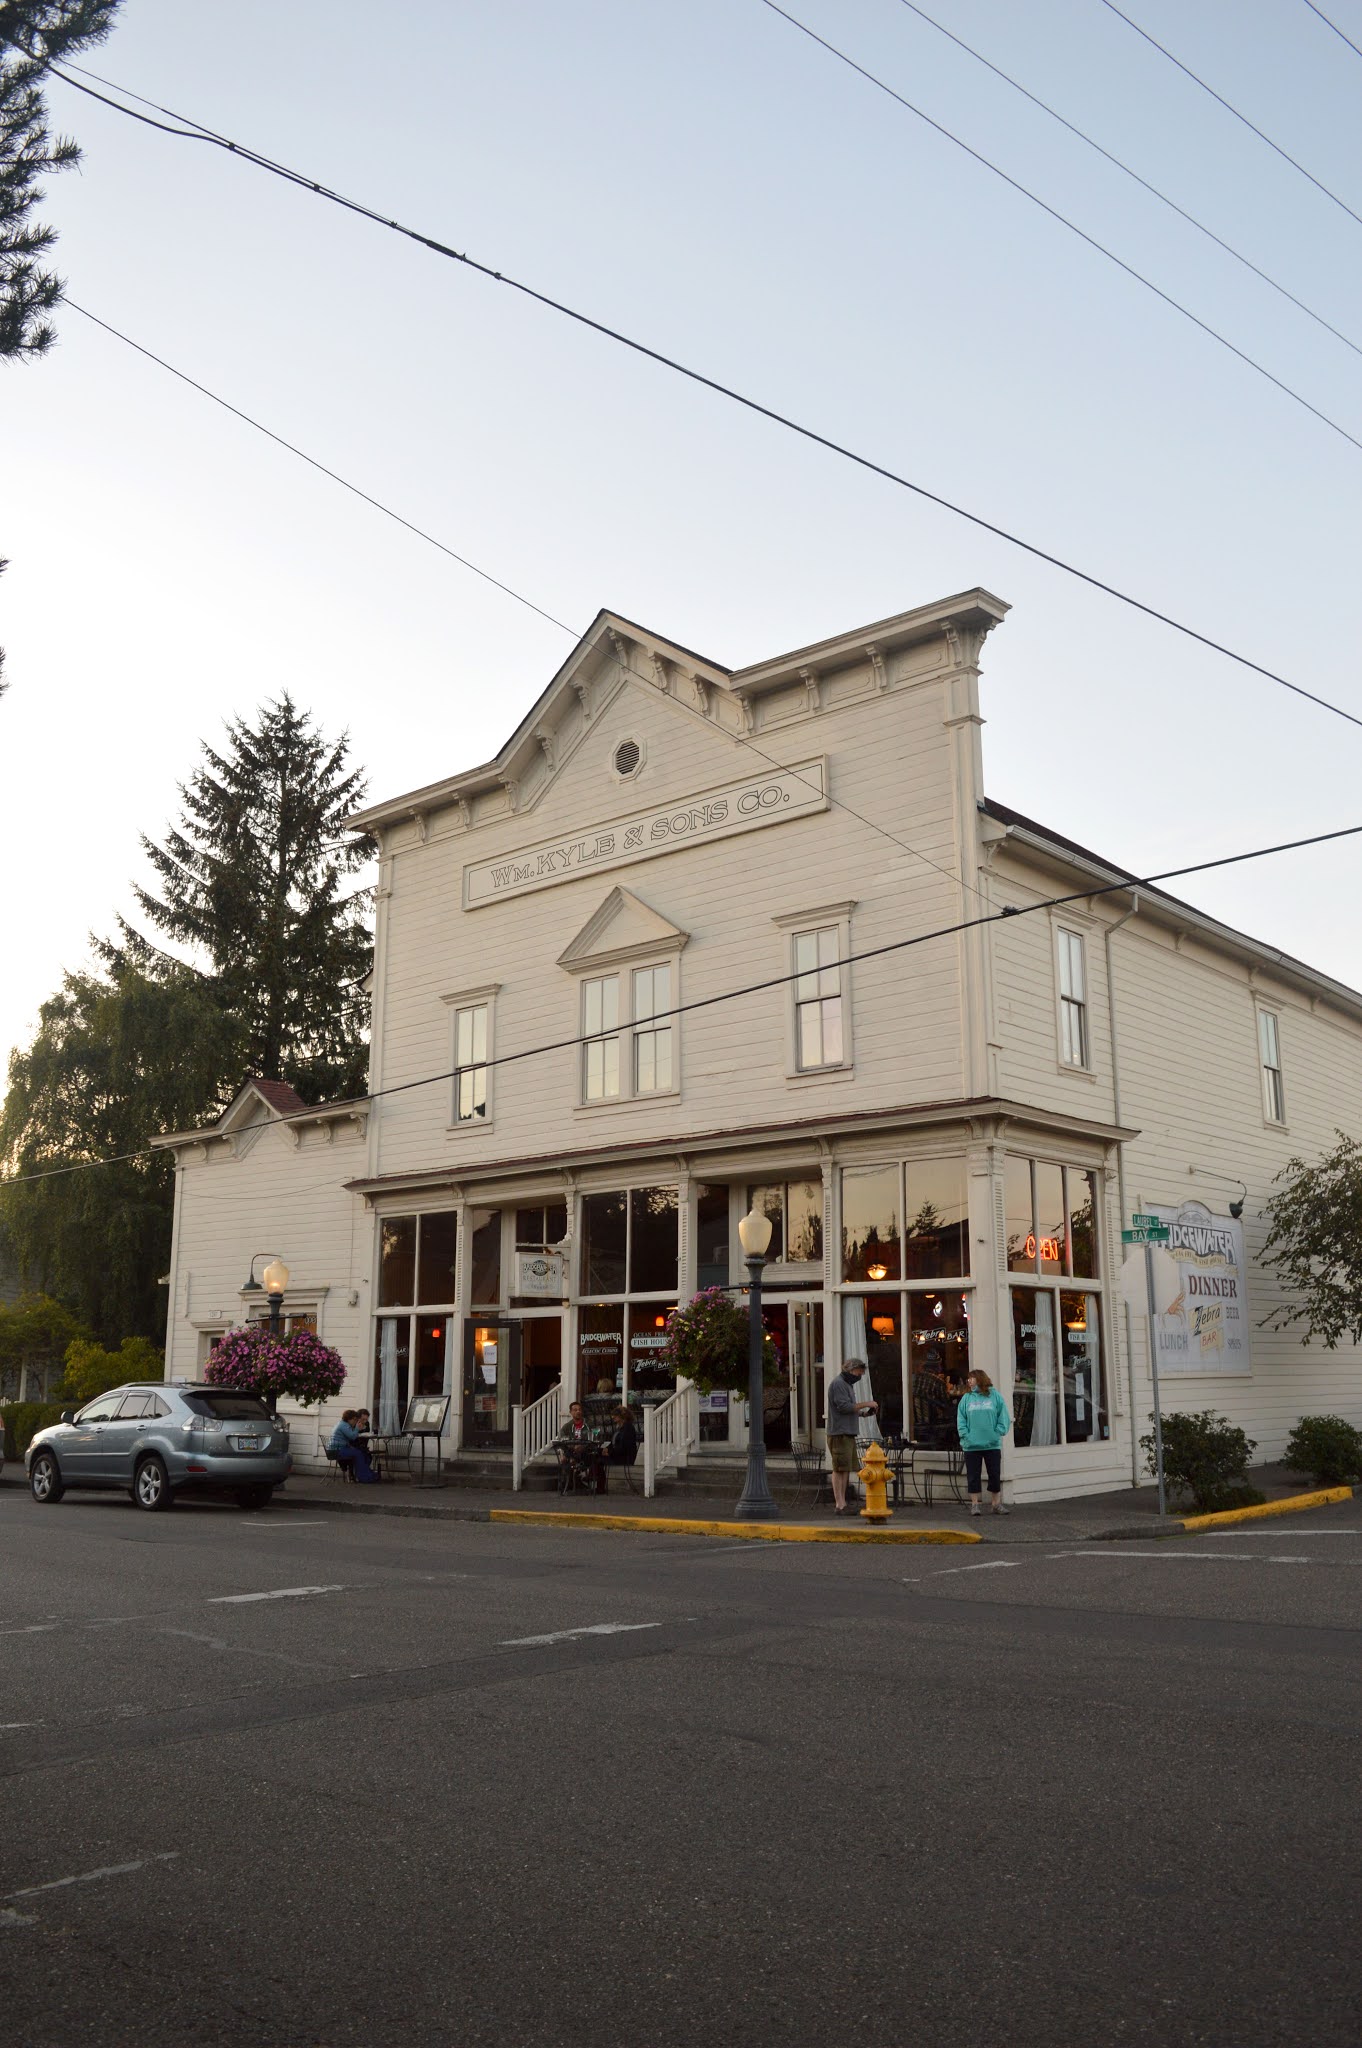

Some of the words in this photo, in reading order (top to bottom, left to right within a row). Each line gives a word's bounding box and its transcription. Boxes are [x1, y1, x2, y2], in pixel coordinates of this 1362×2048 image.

[623, 826, 644, 850] &
[650, 800, 730, 841] SONS
[736, 785, 791, 814] CO.
[1133, 1215, 1152, 1227] LAUREL
[1132, 1230, 1148, 1241] BAY
[1149, 1223, 1237, 1265] IDGEWATER
[1026, 1234, 1059, 1261] OPEN
[1188, 1274, 1238, 1298] DINNER
[1194, 1305, 1221, 1337] Zebra
[580, 1332, 622, 1346] BRIDGEWATER
[947, 1330, 965, 1340] BAR
[1159, 1332, 1189, 1351] LUNCH
[1202, 1331, 1217, 1346] BAR
[635, 1359, 657, 1373] Zebra
